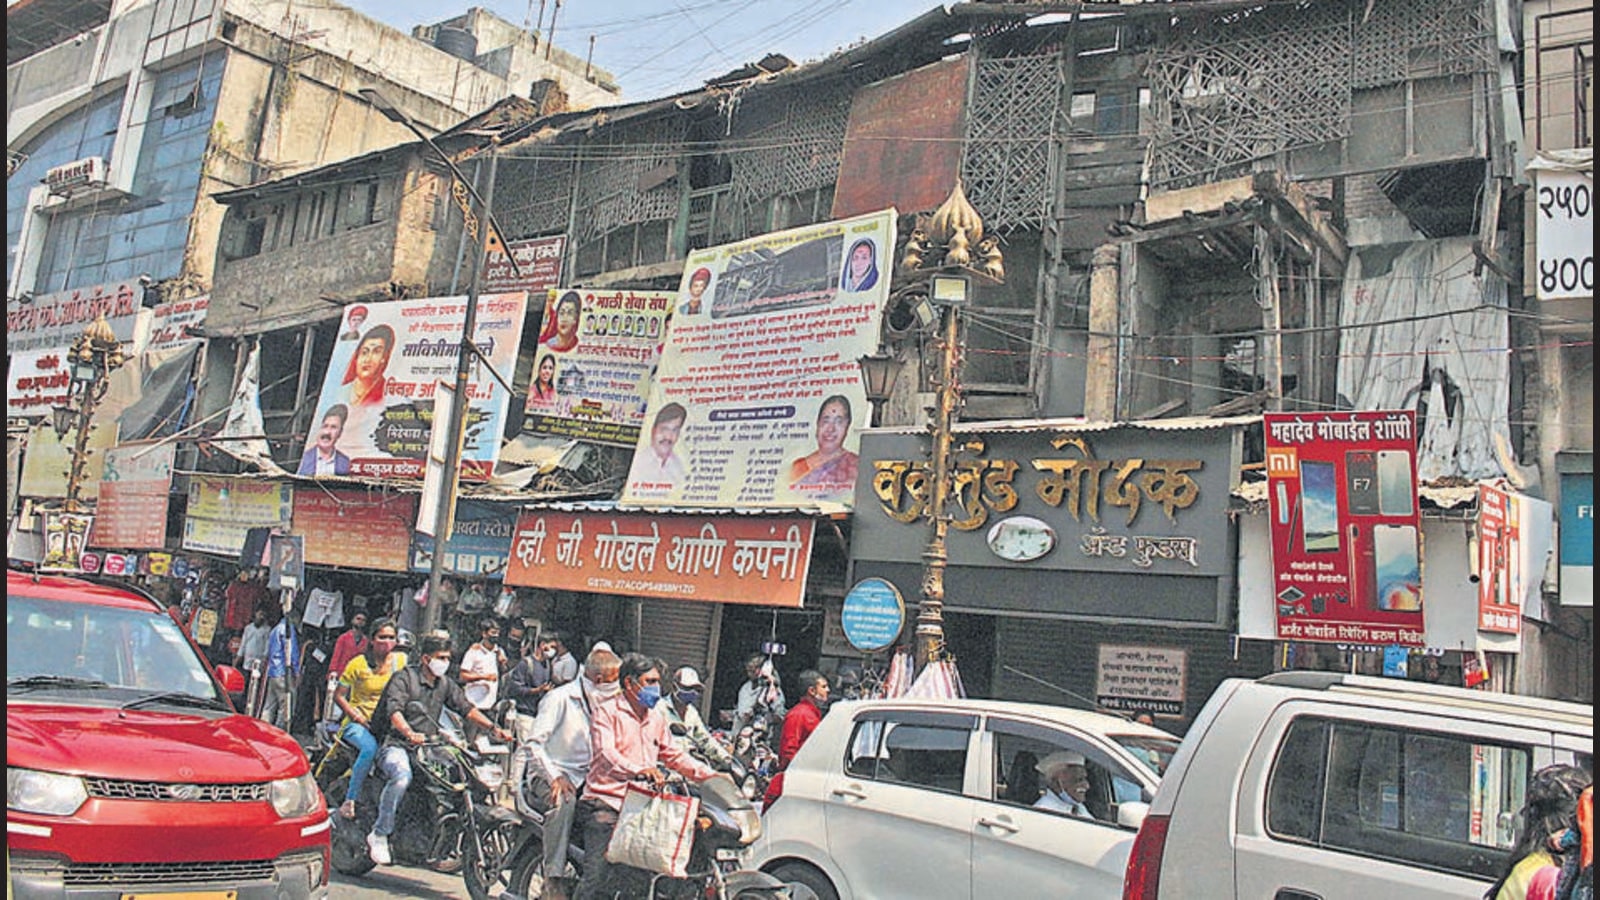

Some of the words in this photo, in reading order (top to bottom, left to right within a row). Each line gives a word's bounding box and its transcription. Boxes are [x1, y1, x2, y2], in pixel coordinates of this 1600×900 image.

[1539, 184, 1593, 219] २५०
[402, 338, 461, 357] सावित्रीमा
[1271, 417, 1314, 444] महादेव
[1317, 416, 1371, 443] मोबाईल
[1374, 414, 1412, 441] शॉपी
[1031, 434, 1205, 527] मोदक
[1353, 478, 1371, 491] F7
[516, 517, 546, 568] व्ही.
[556, 518, 583, 568] जी.
[594, 520, 660, 573] गोखले
[665, 522, 726, 576] आणि
